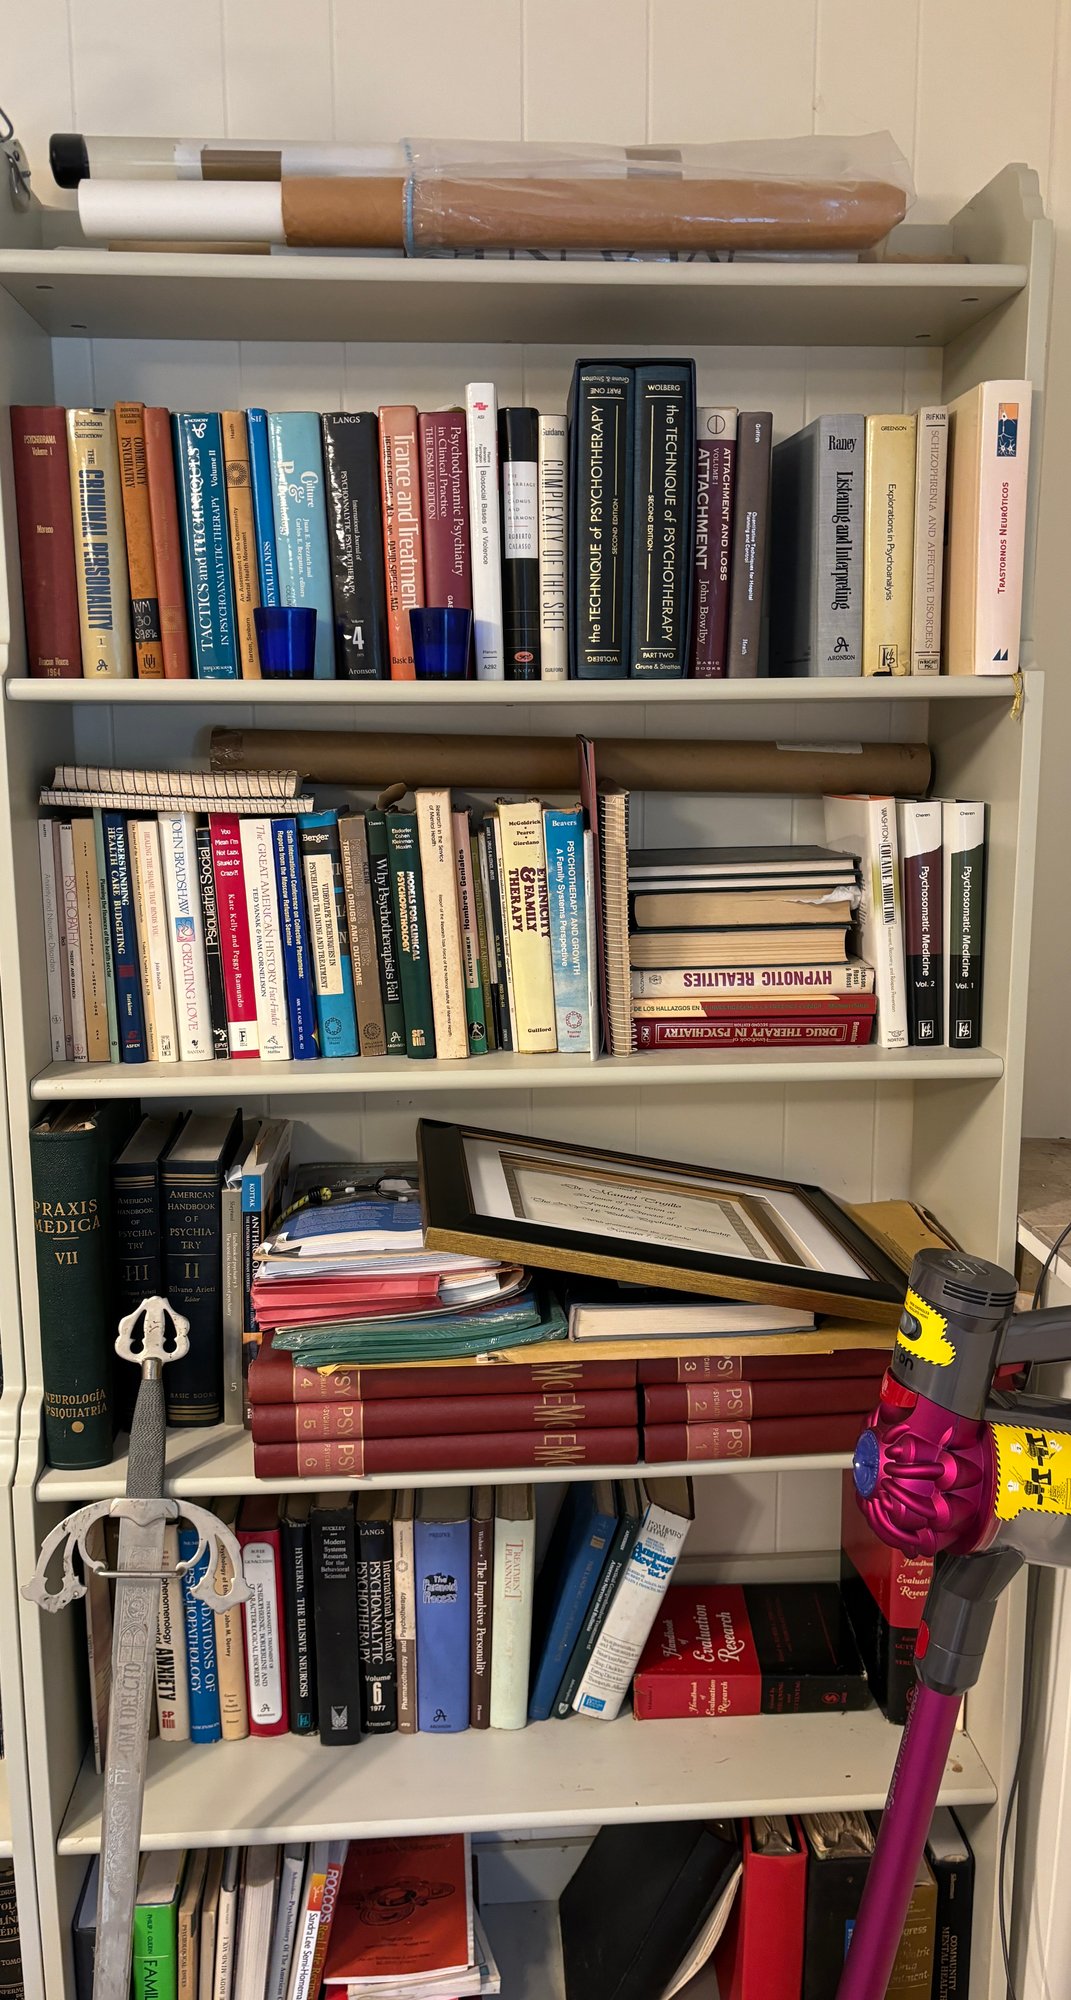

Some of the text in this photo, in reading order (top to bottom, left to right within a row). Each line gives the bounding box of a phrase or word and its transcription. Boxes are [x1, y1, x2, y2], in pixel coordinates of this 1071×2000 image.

[121, 437, 146, 488] COMMUNITY PSYCHIATRY
[210, 457, 218, 486] Volume
[426, 427, 436, 519] THE DSM-IV EDITION
[439, 427, 448, 517] in Clinical Practice
[828, 436, 857, 452] Raney
[929, 431, 939, 511] SCHIZOPHRENIA
[79, 470, 107, 537] CRIMINAL
[448, 426, 464, 576] Psychodynamic Psychiatry
[722, 448, 731, 521] ATTACHMENT
[886, 484, 896, 533] Explorations
[394, 432, 419, 611] Trance and Treatment
[589, 405, 603, 642] the TECHNIQUE of PSYCHOTHERAPY
[661, 405, 679, 641] the TECHNIQUE of PSYCHOTHERAPY
[695, 448, 710, 644] ATTACHMENT John Bowlby
[831, 472, 853, 610] Listening and Interpreting
[83, 542, 113, 631] PERSONALITY
[211, 496, 229, 645] IN PSYCHOANALYTIC THERAPY
[885, 544, 894, 600] Psychoanalysis
[194, 557, 214, 652] TACTICS and
[925, 596, 933, 648] DISORDERS
[353, 627, 364, 649] 4
[108, 827, 125, 955] HEALTH CARE BUDGETING
[115, 827, 129, 905] UNDERSTANDING
[556, 856, 565, 883] Family
[880, 807, 895, 923] WASHTON COCAINE ADDICTION
[170, 818, 198, 1030] JOHN BRADSHAW CREATING LOVE
[229, 913, 238, 932] Kelly
[255, 825, 277, 984] The GREAT AMERICAN HISTORY
[322, 883, 332, 918] VIDEOTAPE
[508, 868, 523, 932] THERAPY
[520, 866, 537, 932] & FAMILY
[557, 885, 567, 919] Systems
[566, 841, 577, 916] PSYCHOTHERAPY
[572, 938, 580, 975] GROWTH
[918, 866, 930, 976] Psychosomatic Medicine
[961, 866, 972, 977] Psychosomatic Medicine
[232, 934, 240, 948] and
[324, 920, 335, 958] TECHNIQUES
[375, 858, 399, 1001] Why Psychotherapists Fail
[558, 920, 568, 967] Perspective
[231, 950, 241, 971] Peggy
[684, 971, 831, 987] HYPNOTIC REALITIES
[235, 973, 244, 1008] Ramundo
[664, 1027, 838, 1037] DRUG THERAPY IN PSYCHIATRY
[34, 1199, 97, 1216] PRAXIS
[248, 1183, 256, 1208] KOTTAK
[34, 1216, 100, 1234] MEDICA
[181, 1241, 201, 1249] TRY
[55, 1252, 79, 1264] VII
[184, 1263, 200, 1279] II
[304, 1420, 316, 1429] 5
[305, 1458, 318, 1467] 6
[294, 1547, 308, 1698] HYSTERIA: THE ELUSIVE NEUROSIS
[357, 1561, 370, 1663] PSYCHOTHERAPY
[369, 1561, 383, 1664] PSYCHOANALYTIC
[383, 1560, 394, 1661] International Journal of
[474, 1560, 487, 1676] The Impulsive Personality
[693, 1604, 715, 1662] Evaluation
[716, 1611, 745, 1662] Research
[157, 1648, 176, 1701] ANXIETY
[689, 1682, 698, 1713] Handbook
[706, 1680, 715, 1716] Evaluation
[718, 1682, 730, 1712] Research
[949, 1935, 957, 1991] COMMUNITY
